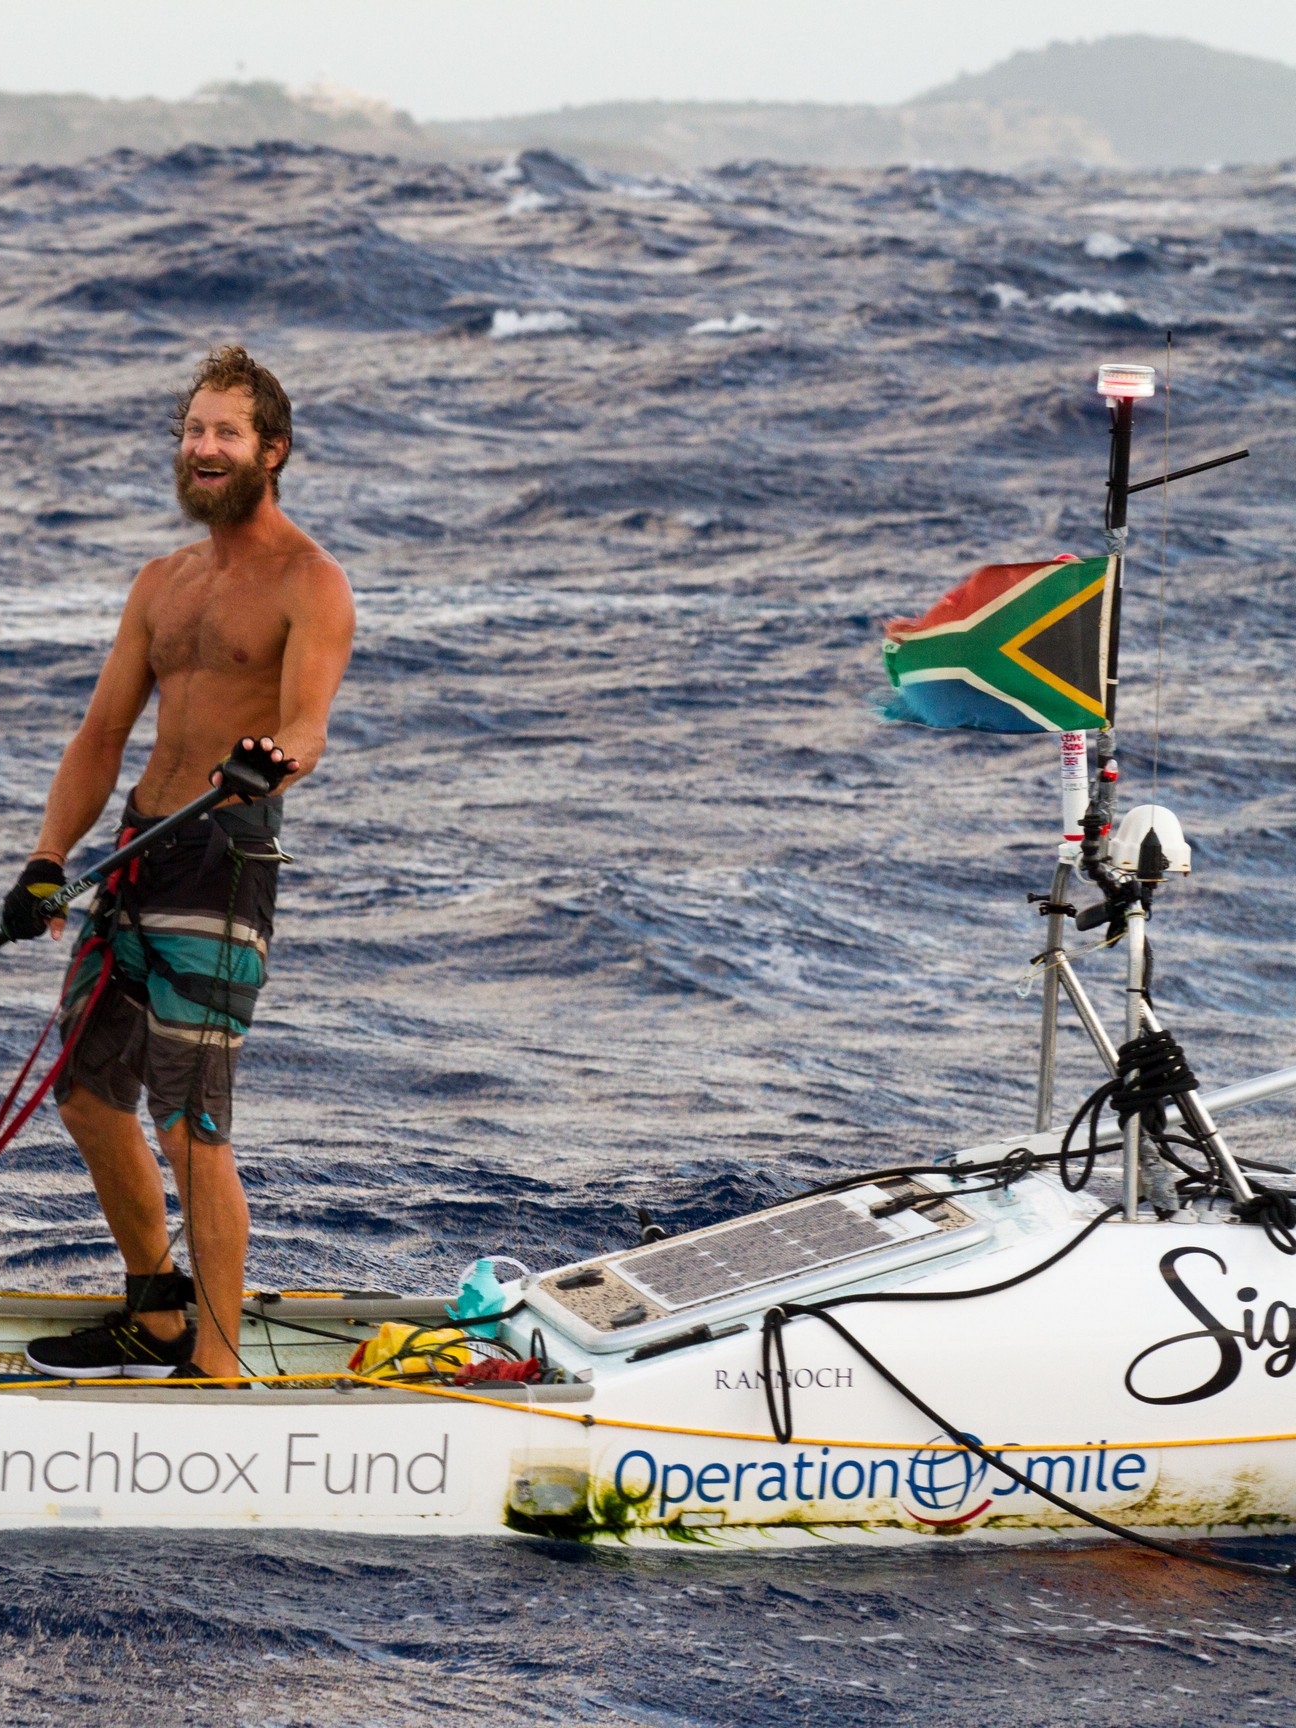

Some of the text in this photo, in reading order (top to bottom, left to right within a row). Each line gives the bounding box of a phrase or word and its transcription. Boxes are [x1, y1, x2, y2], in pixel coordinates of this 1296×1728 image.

[1124, 1246, 1296, 1405] Sig
[714, 1367, 855, 1390] RANNOCH
[284, 1432, 450, 1495] Fund
[614, 1440, 1147, 1516] Operation Smile
